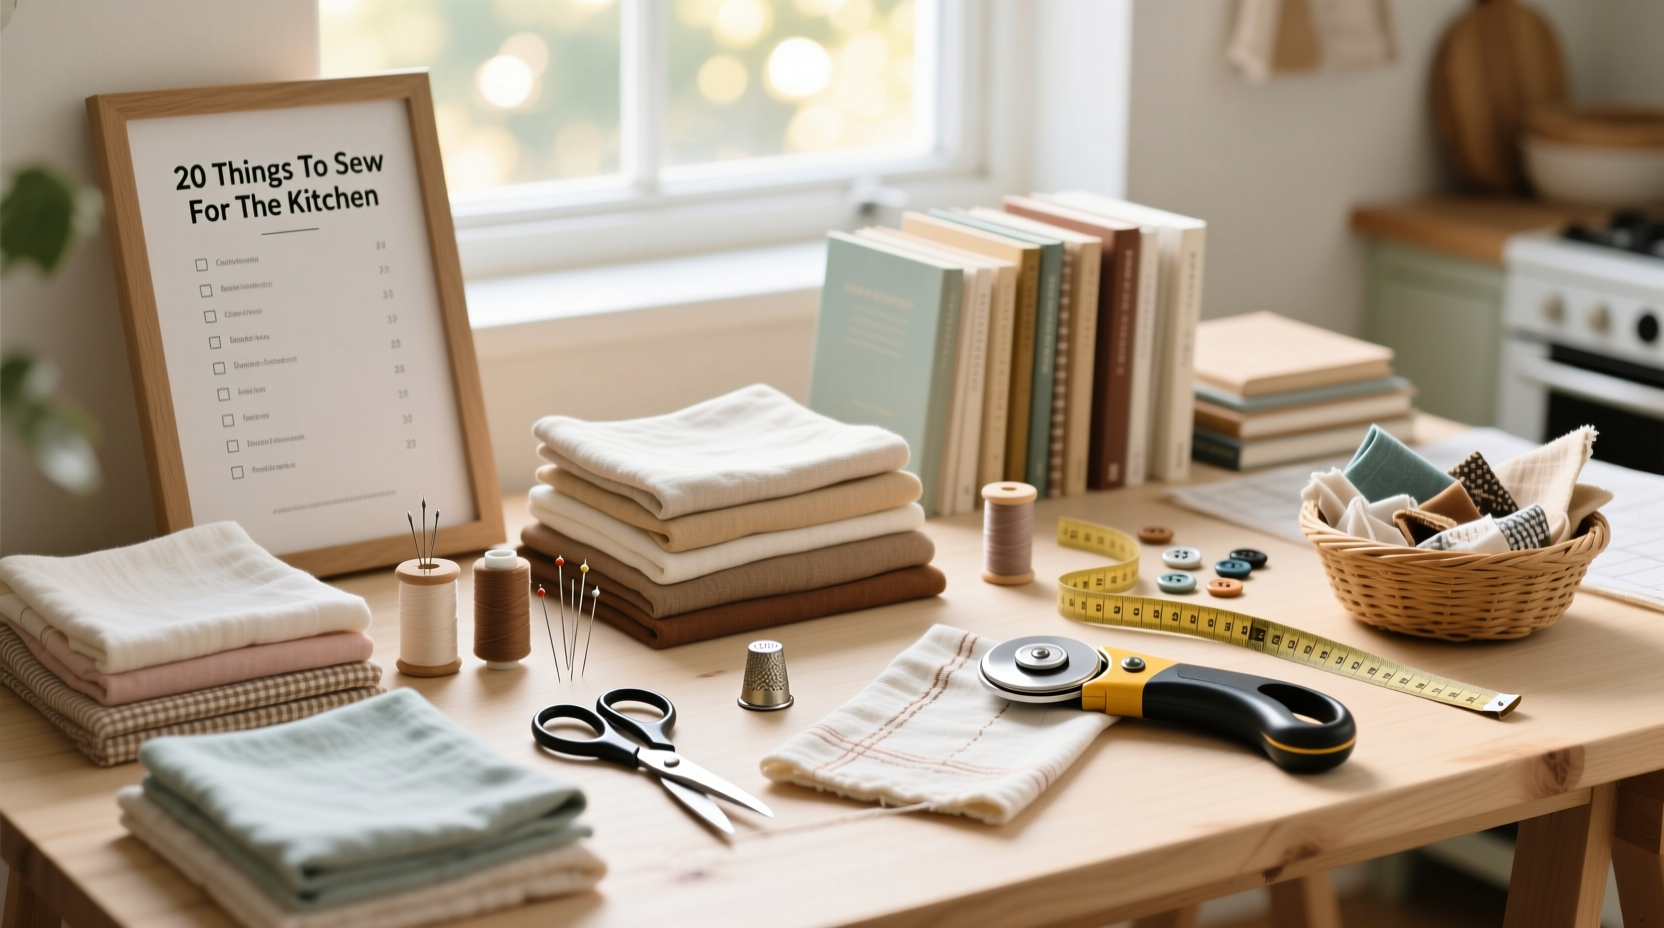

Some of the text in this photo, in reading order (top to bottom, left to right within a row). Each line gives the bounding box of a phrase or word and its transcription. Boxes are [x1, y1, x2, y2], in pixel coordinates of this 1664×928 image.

[173, 151, 384, 191] 20 Things To Sew
[188, 185, 379, 225] For The Kitchen
